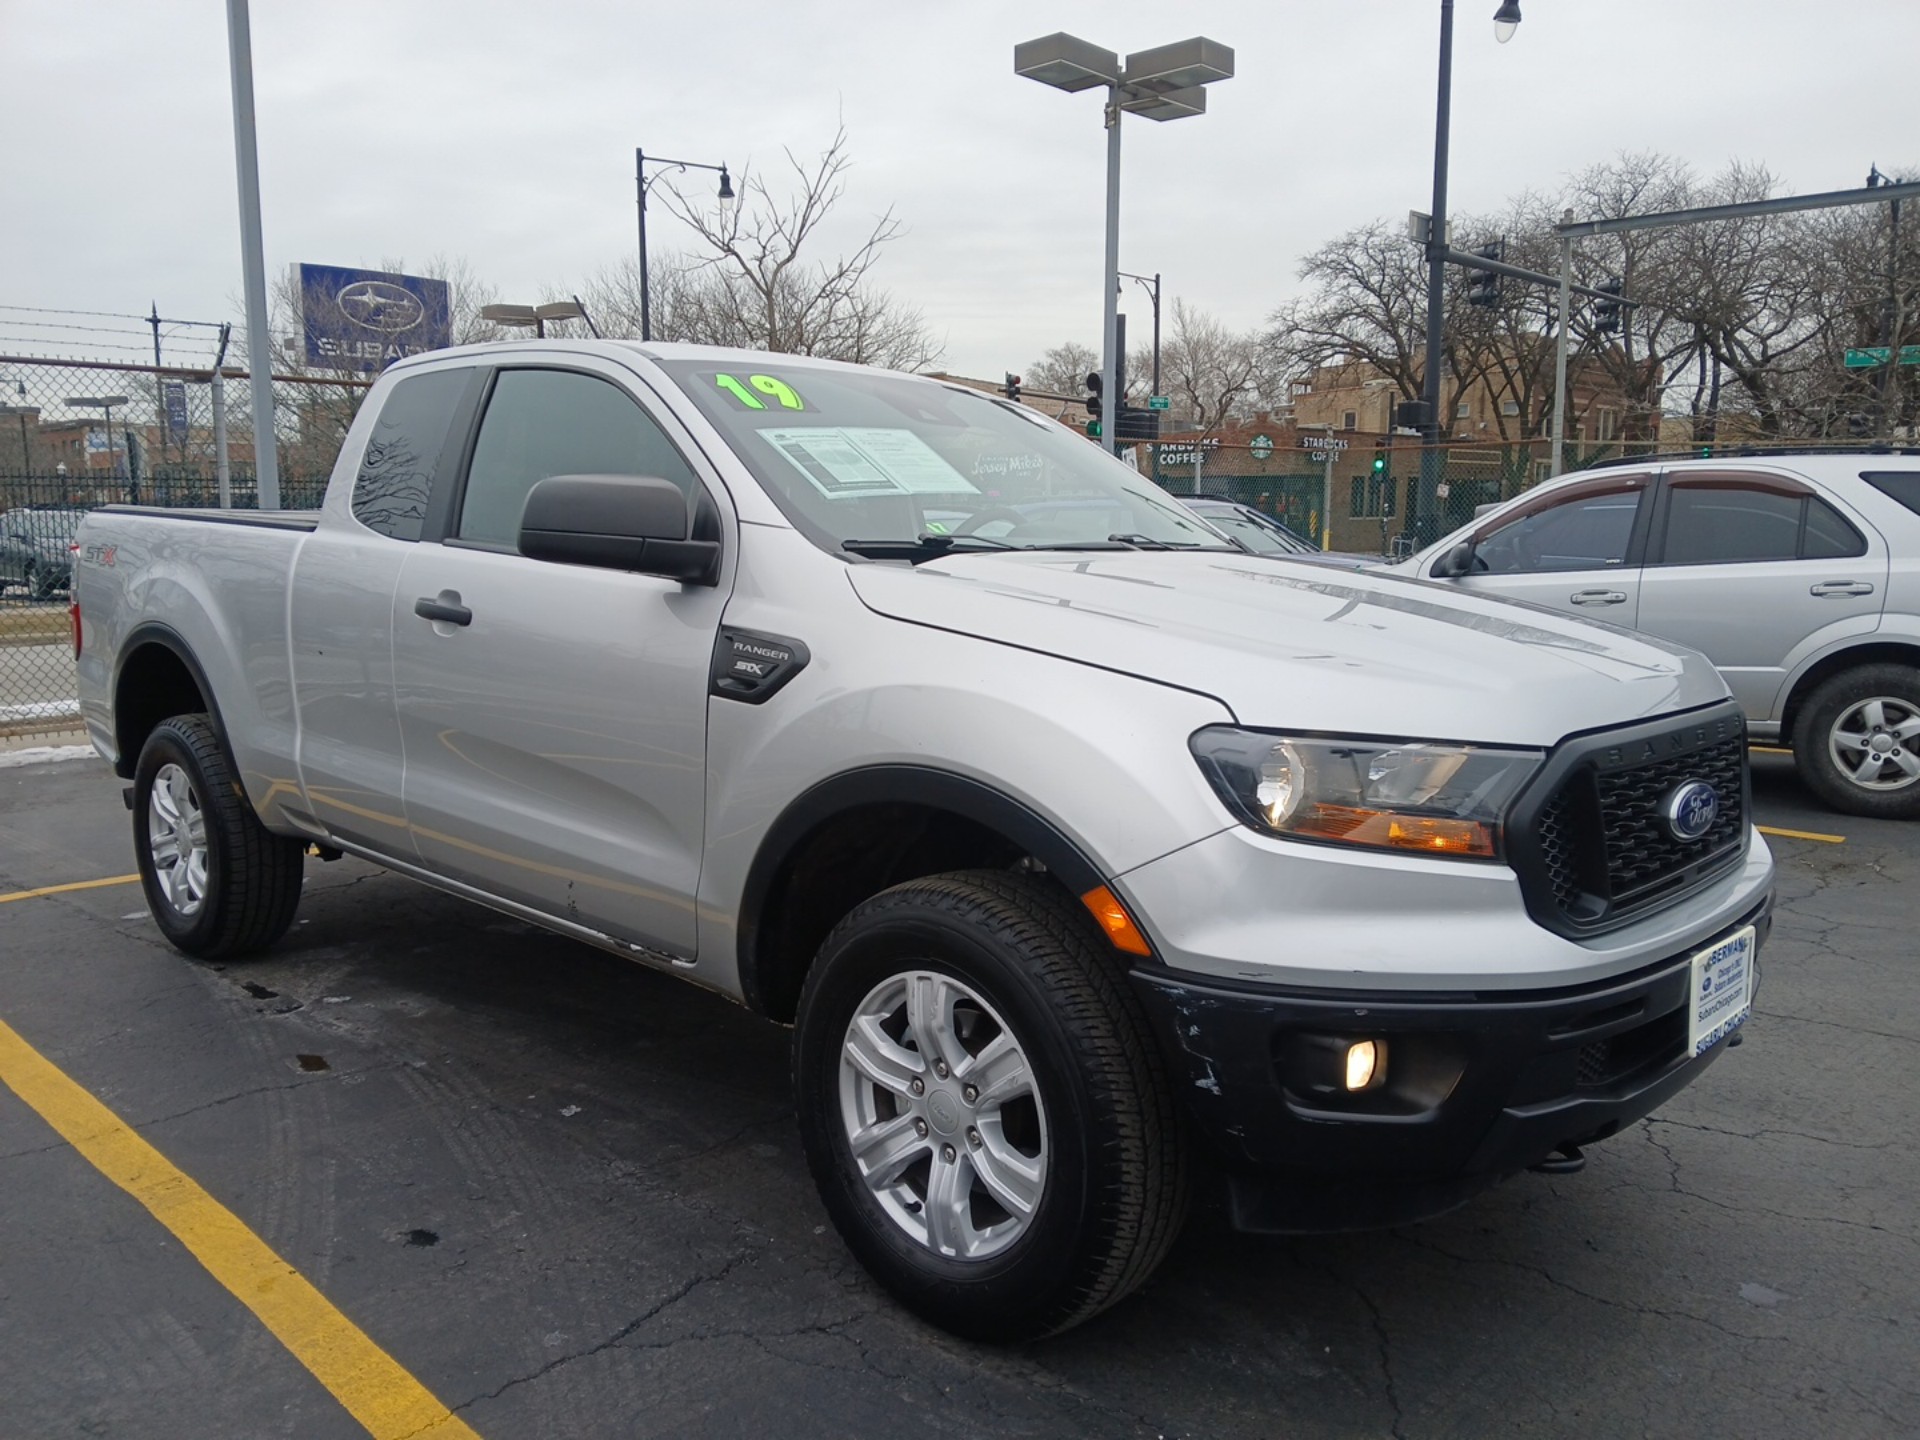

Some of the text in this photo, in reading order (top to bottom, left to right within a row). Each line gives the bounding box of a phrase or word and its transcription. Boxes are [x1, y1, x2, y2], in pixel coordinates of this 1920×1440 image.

[317, 338, 430, 360] SUBAR
[716, 373, 804, 411] 19
[1312, 451, 1339, 462] COFEE
[84, 544, 118, 567] STX
[733, 642, 789, 660] RANGER
[734, 661, 763, 675] STX
[1608, 714, 1742, 766] RANGER
[1688, 792, 1714, 827] Ford
[1711, 936, 1746, 965] BERMAN
